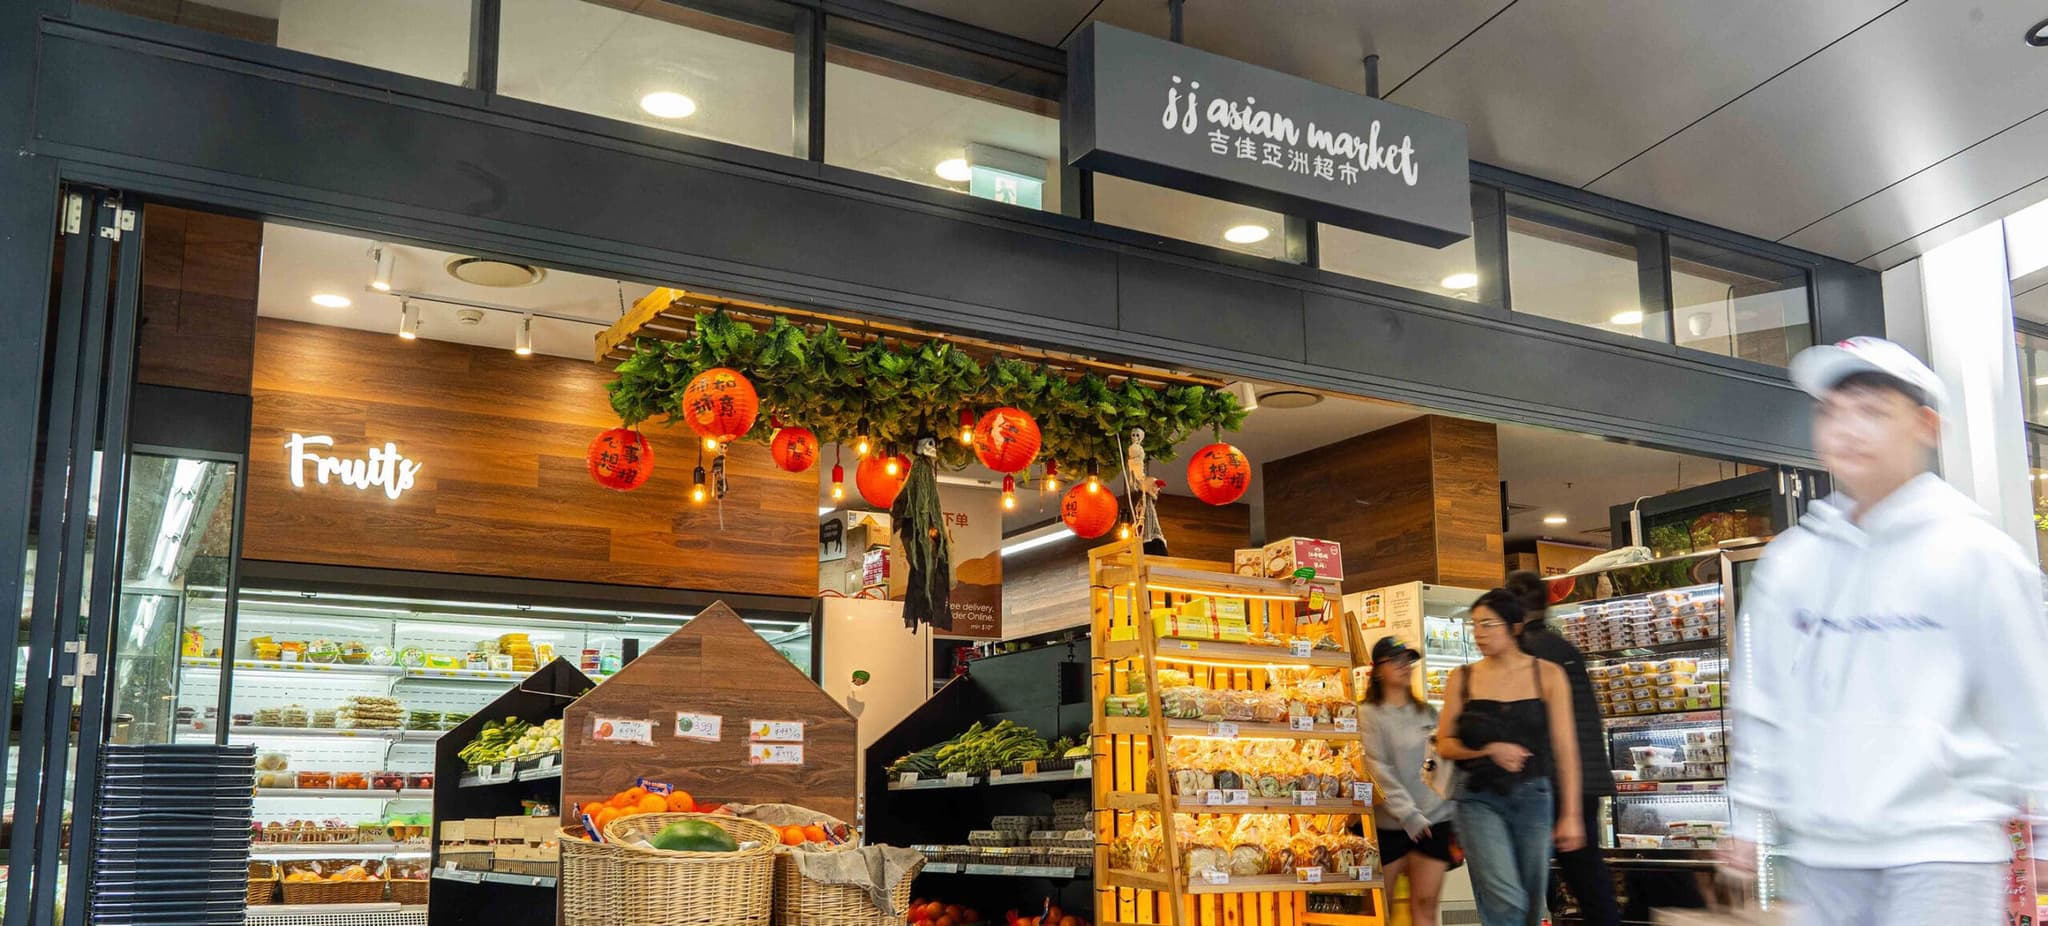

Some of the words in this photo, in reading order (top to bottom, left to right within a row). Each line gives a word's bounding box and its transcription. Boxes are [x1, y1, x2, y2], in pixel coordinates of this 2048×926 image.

[1206, 97, 1300, 147] asian
[1306, 119, 1419, 187] market
[1207, 128, 1360, 185] 吉佳亞洲超市
[284, 432, 423, 500] Fruits
[942, 511, 969, 528] 下单
